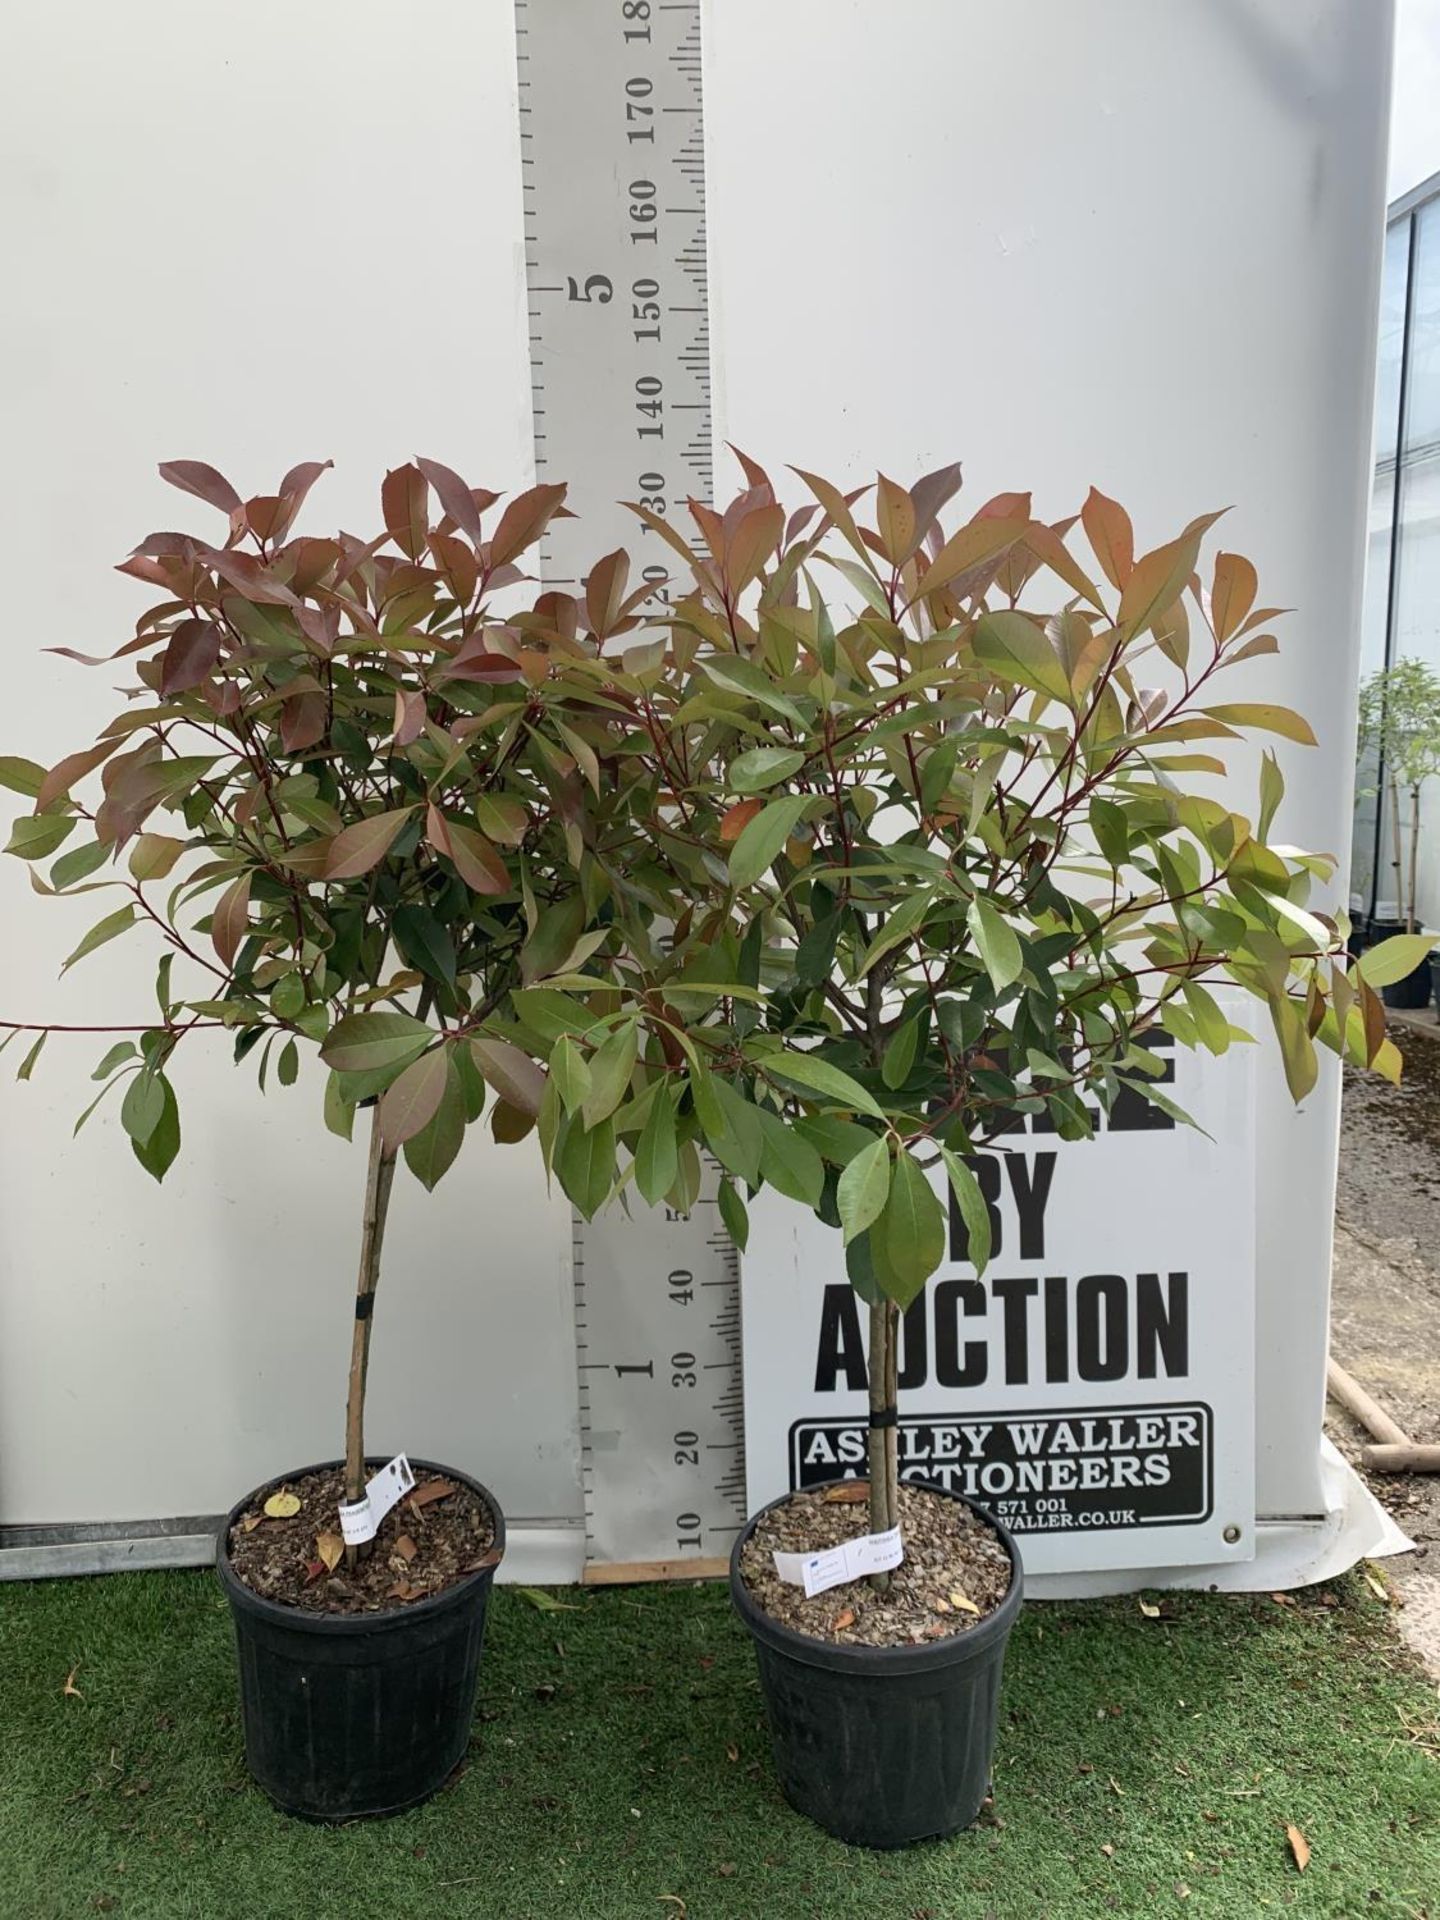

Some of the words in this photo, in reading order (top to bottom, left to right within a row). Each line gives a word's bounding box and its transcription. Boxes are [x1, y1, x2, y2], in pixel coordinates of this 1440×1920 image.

[625, 77, 655, 144] 170
[629, 180, 658, 245] 160
[567, 274, 613, 304] 5
[632, 278, 661, 342] 150
[635, 376, 664, 440] 140
[642, 565, 669, 622] 20
[947, 1151, 1058, 1263] BY
[668, 1269, 694, 1307] 40
[614, 1359, 654, 1379] 1
[671, 1351, 698, 1389] 30
[674, 1430, 700, 1467] 20
[804, 1424, 993, 1465] ASLEY
[1007, 1415, 1200, 1456] WALLER
[842, 1454, 1172, 1496] CTIONEERS
[997, 1500, 1028, 1516] 571
[1035, 1498, 1067, 1513] 001
[676, 1512, 702, 1550] 10
